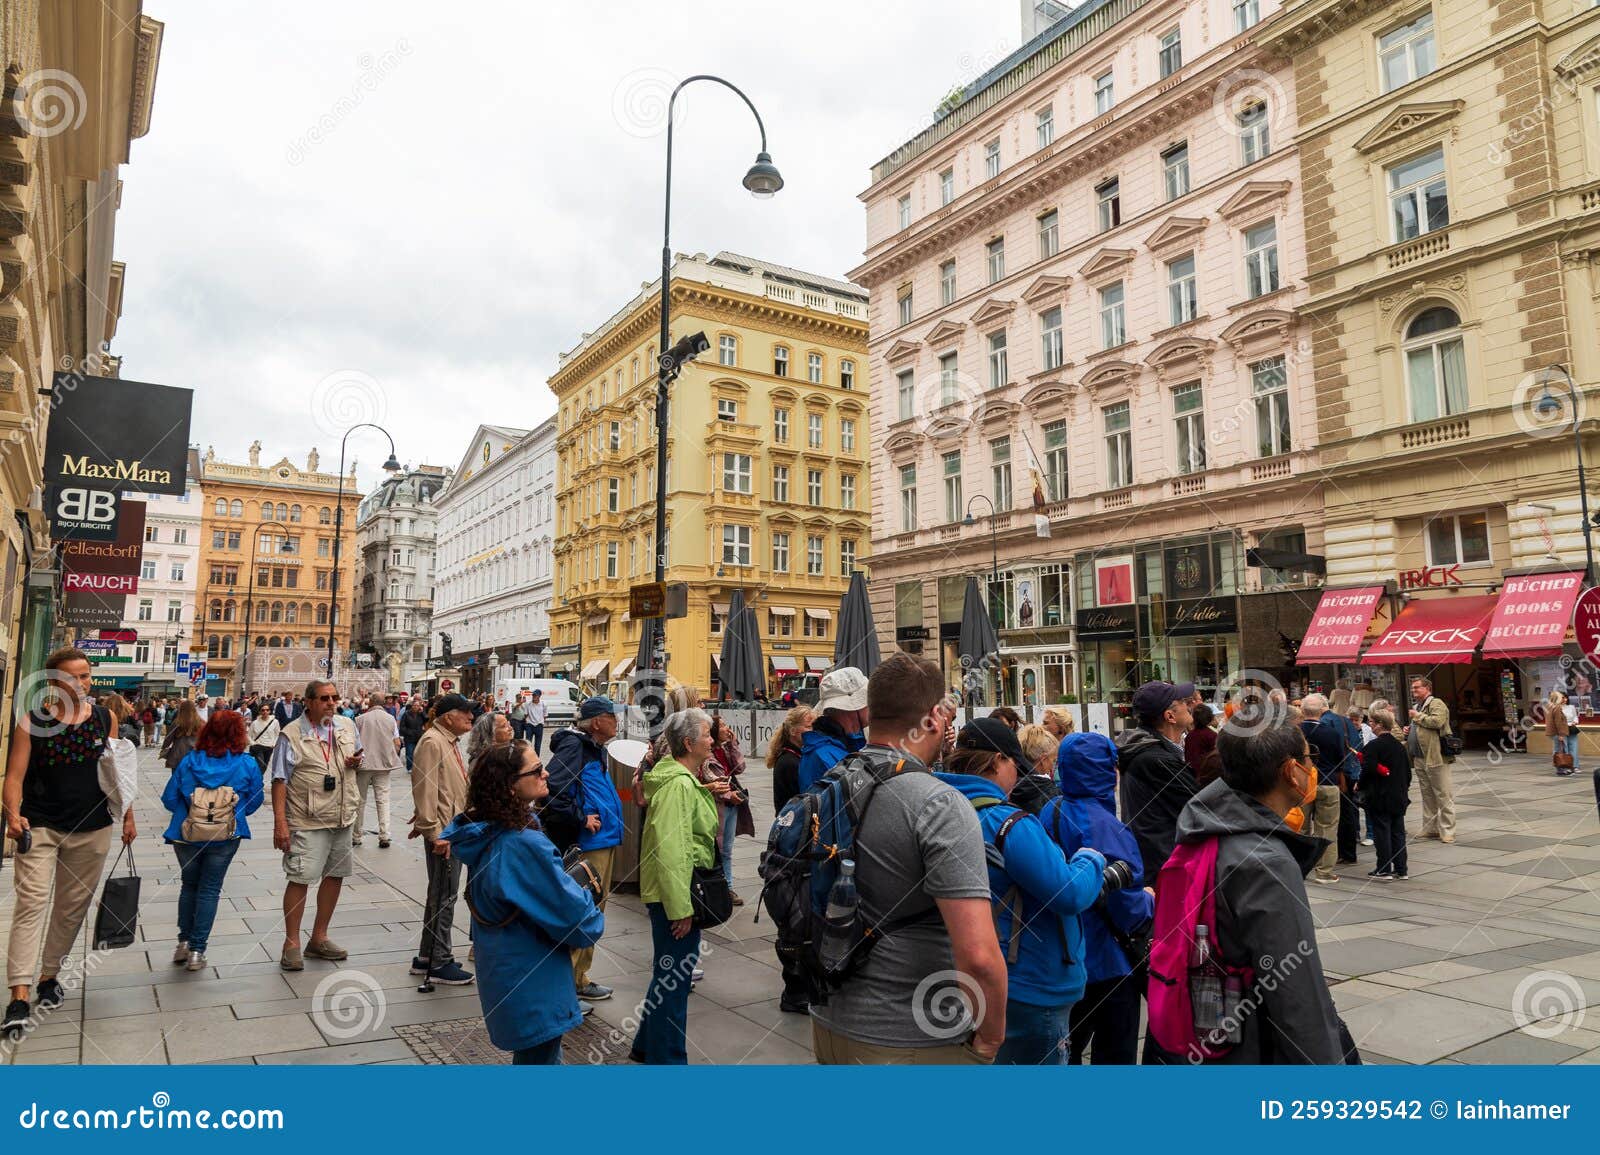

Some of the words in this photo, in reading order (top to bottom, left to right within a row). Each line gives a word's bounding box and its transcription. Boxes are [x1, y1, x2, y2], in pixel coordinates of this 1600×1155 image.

[60, 454, 171, 484] MaxMara
[66, 574, 132, 589] RAUCH
[1399, 563, 1463, 588] FRICK
[1506, 577, 1577, 594] BÜCHER
[1320, 594, 1376, 608] BÜCHER
[1503, 600, 1564, 616] BOOKS
[68, 607, 123, 615] LONGCHAMP
[1317, 614, 1363, 627] BOOKS
[1380, 627, 1480, 646] FRICK
[1491, 623, 1562, 638] BÜCHER
[1305, 634, 1360, 647] BÜCHER
[91, 678, 116, 686] Meinl
